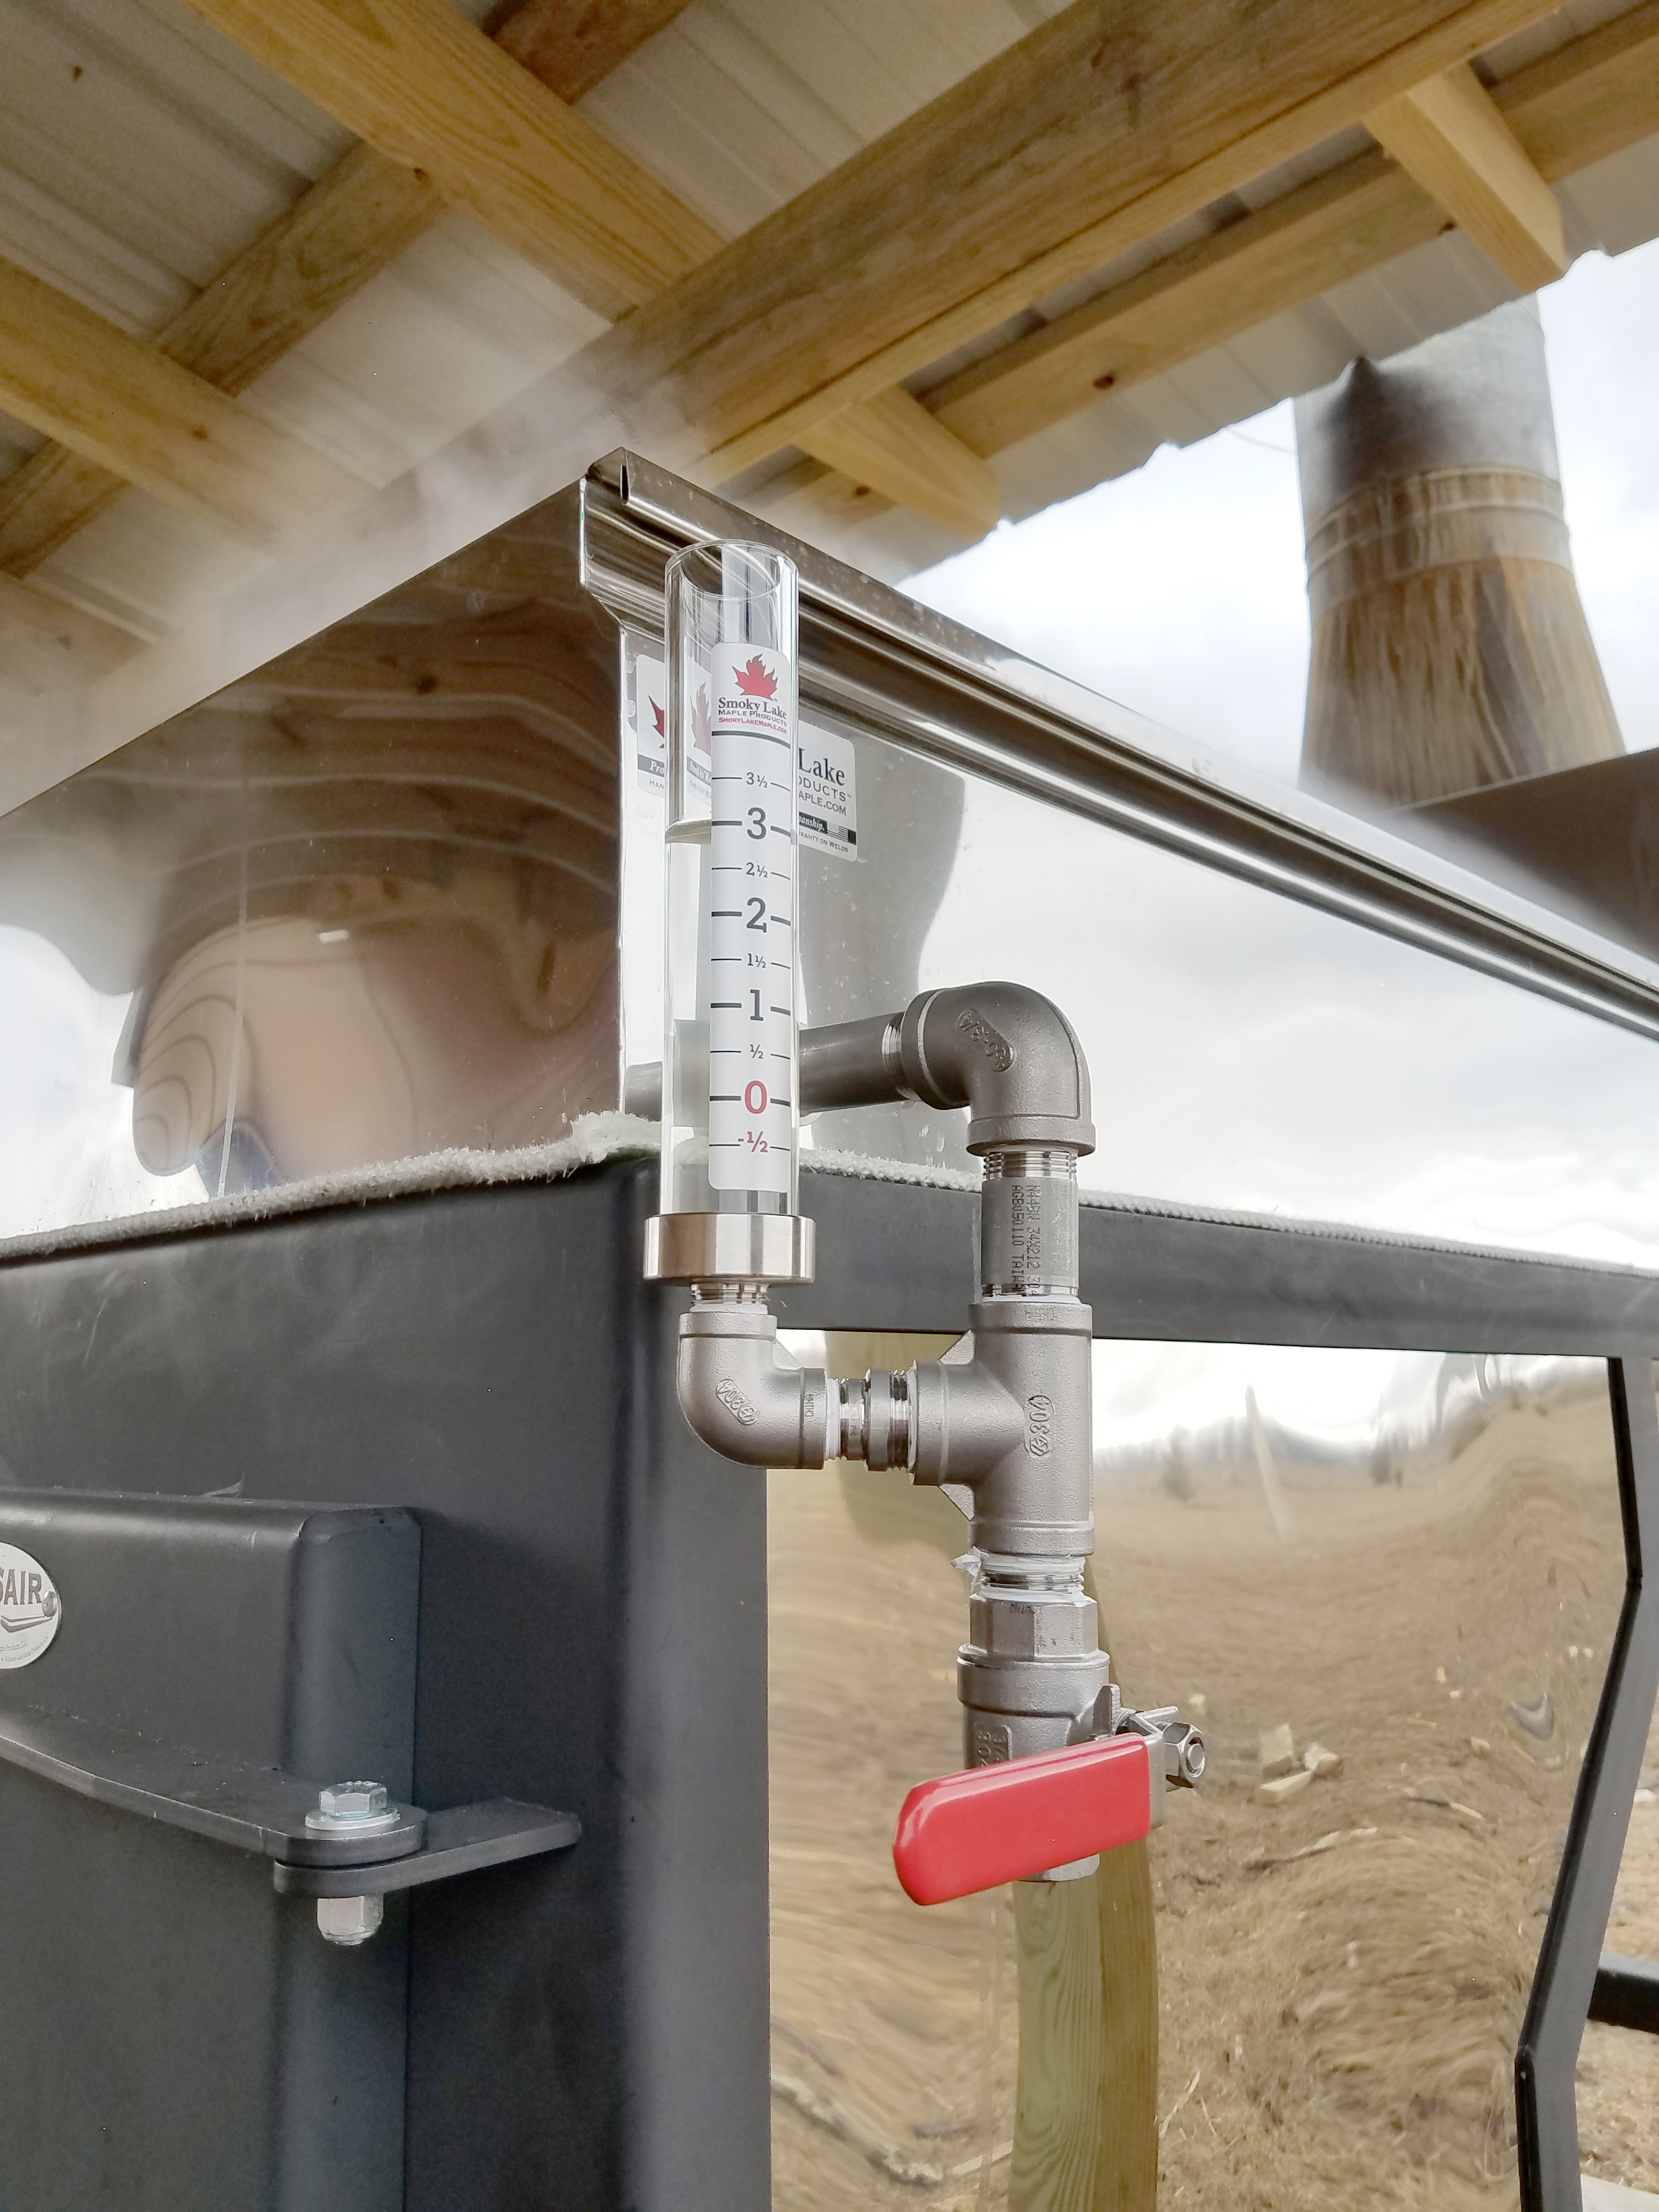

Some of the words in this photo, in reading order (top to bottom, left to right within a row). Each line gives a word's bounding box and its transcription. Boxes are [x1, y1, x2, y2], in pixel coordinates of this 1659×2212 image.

[719, 697, 760, 712] Smoky
[763, 702, 787, 719] Lake
[799, 748, 845, 786] Lake
[747, 807, 766, 839] 3
[747, 898, 767, 933] 2
[750, 989, 764, 1021] 1
[744, 1081, 767, 1114] 0
